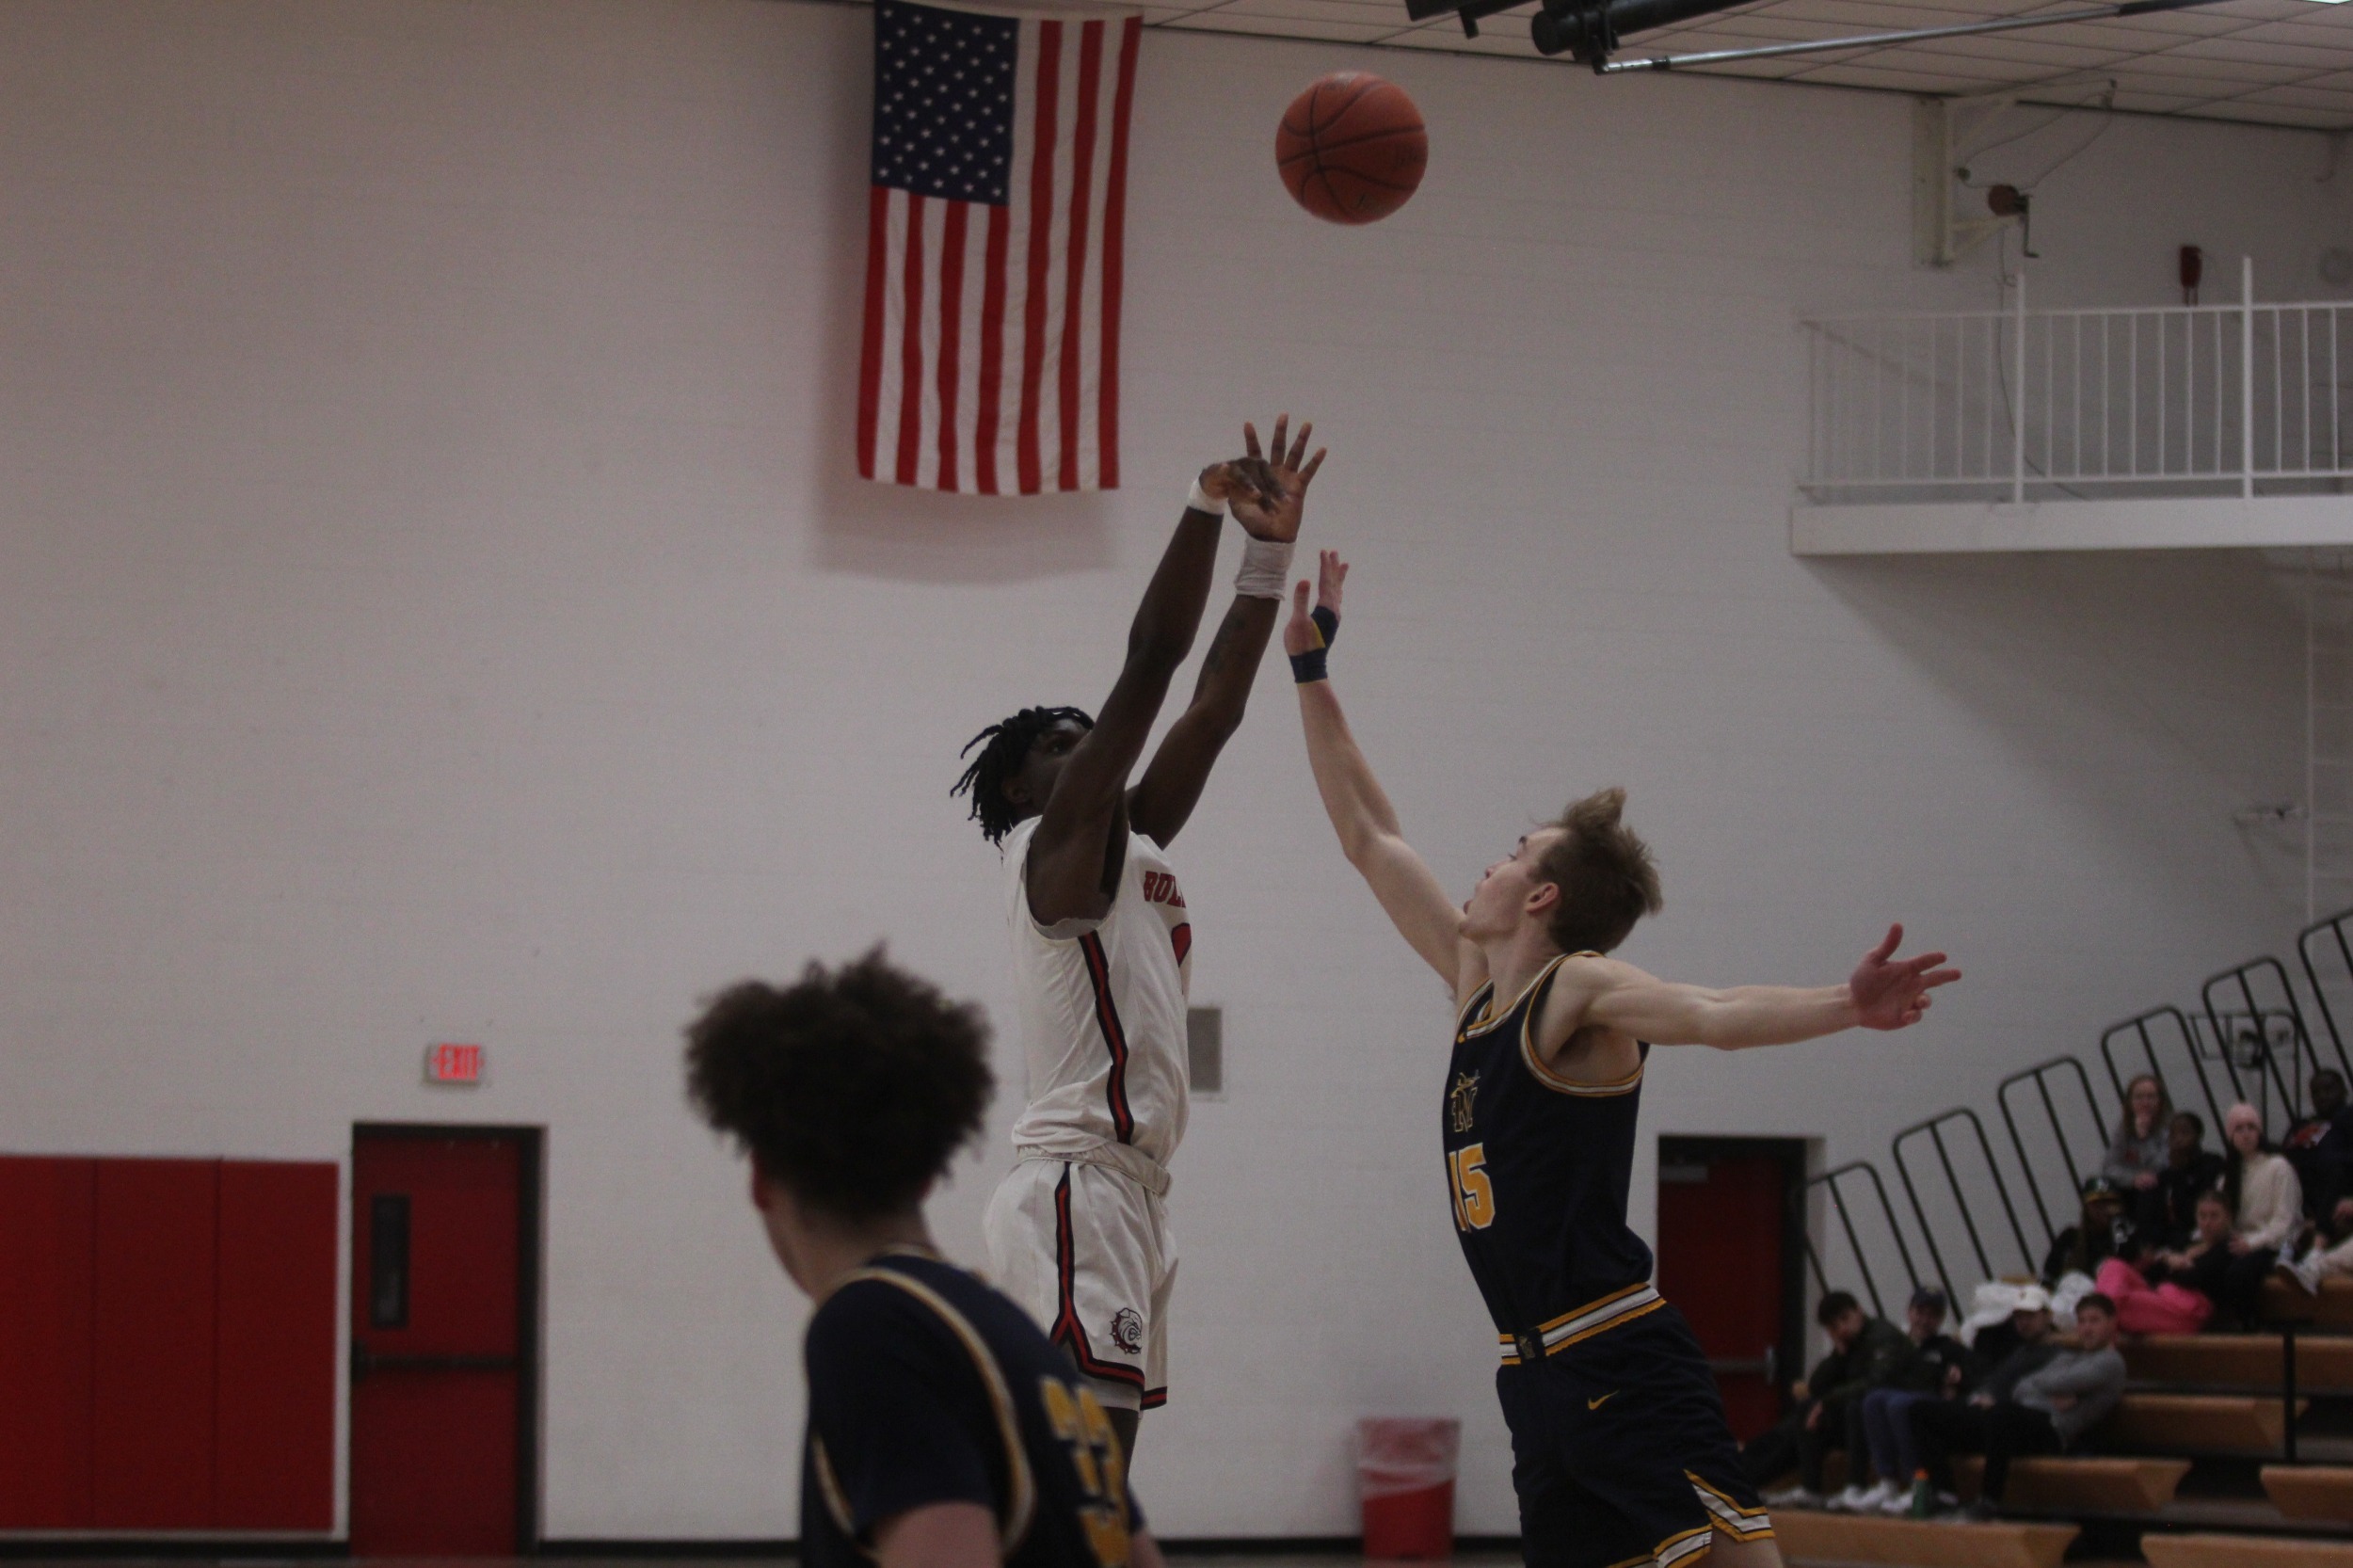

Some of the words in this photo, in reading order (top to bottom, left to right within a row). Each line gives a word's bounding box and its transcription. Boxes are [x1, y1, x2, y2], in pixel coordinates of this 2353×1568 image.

[1144, 871, 1186, 908] BUL
[439, 1044, 479, 1080] EXIT
[1449, 1142, 1497, 1233] 15
